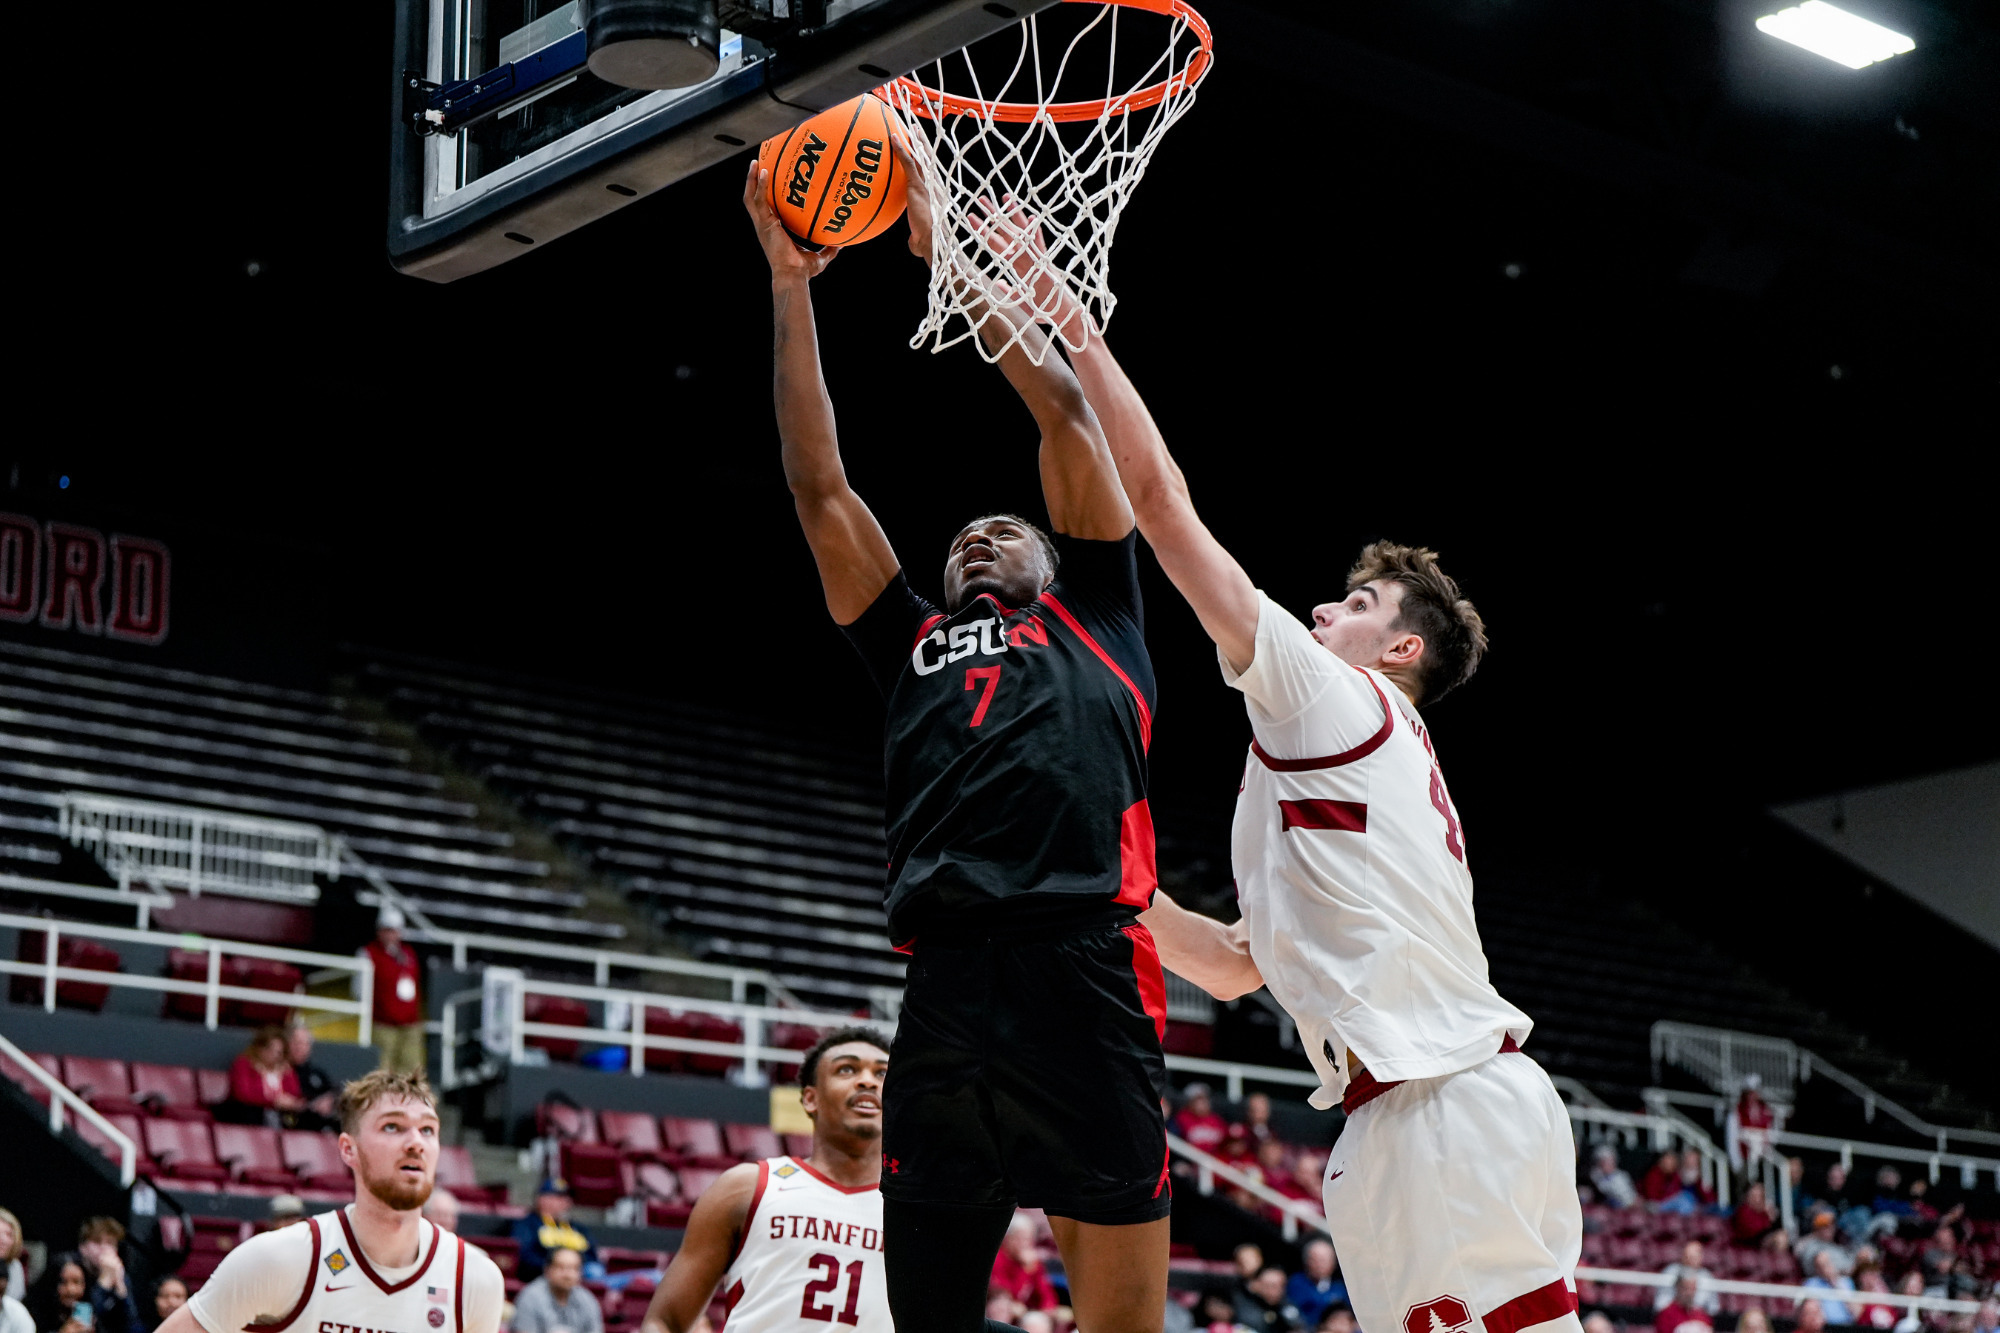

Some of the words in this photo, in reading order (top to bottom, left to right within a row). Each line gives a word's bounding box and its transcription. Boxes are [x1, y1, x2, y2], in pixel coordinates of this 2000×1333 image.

[786, 132, 828, 209] NCAA
[823, 138, 883, 234] Wilson
[832, 188, 842, 203] NXT
[839, 171, 848, 187] EVO
[964, 664, 1002, 728] 7
[770, 1214, 884, 1253] STANFO
[800, 1252, 864, 1327] 21
